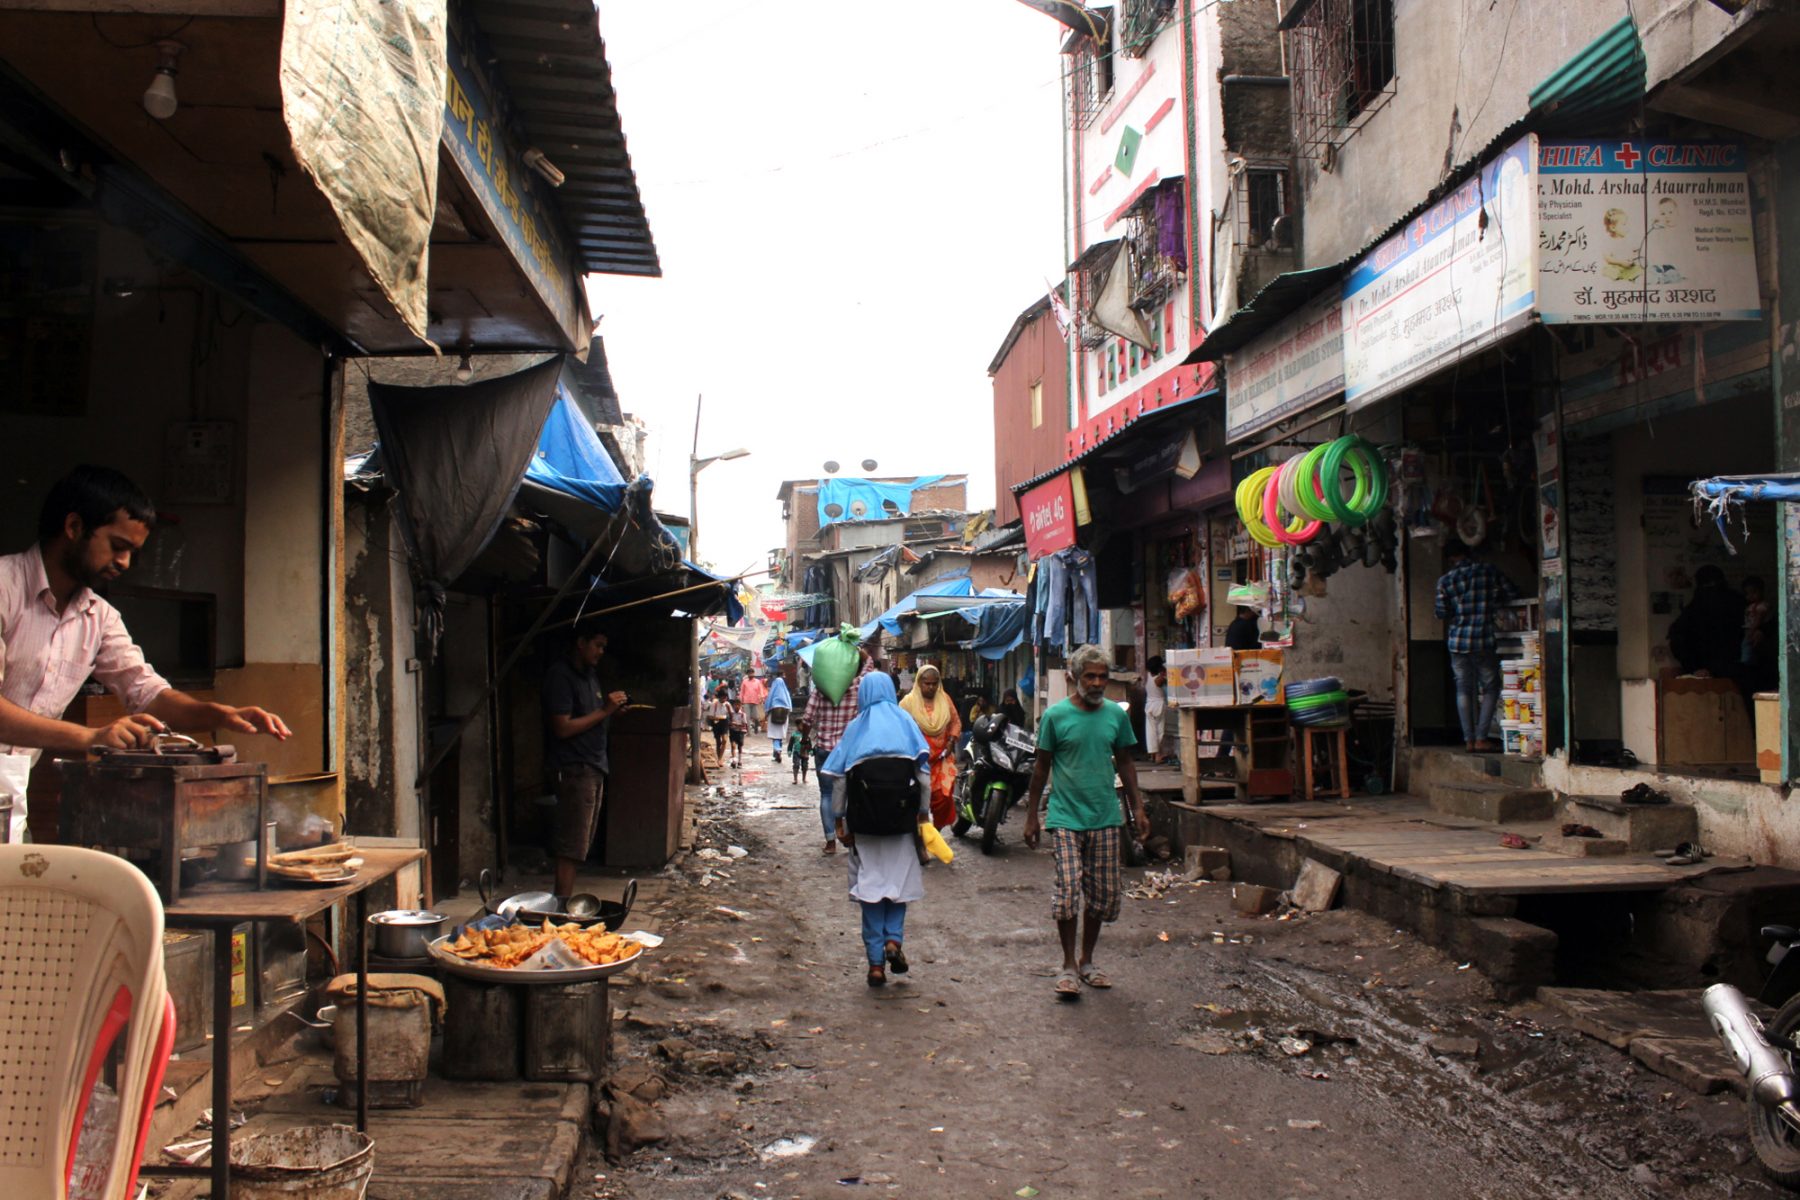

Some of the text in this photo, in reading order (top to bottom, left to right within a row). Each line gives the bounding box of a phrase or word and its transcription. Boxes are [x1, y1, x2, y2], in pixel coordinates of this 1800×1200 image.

[1647, 144, 1737, 167] CLINIC
[1551, 178, 1594, 195] Mohd.
[1599, 178, 1648, 195] Arshad
[1652, 177, 1744, 194] Ataurrahman
[1429, 177, 1480, 234] CLINIC
[1549, 200, 1582, 210] Physician
[1573, 286, 1717, 310] डॉ. मुहम्मद अरशद
[1035, 495, 1065, 531] airtel 4G
